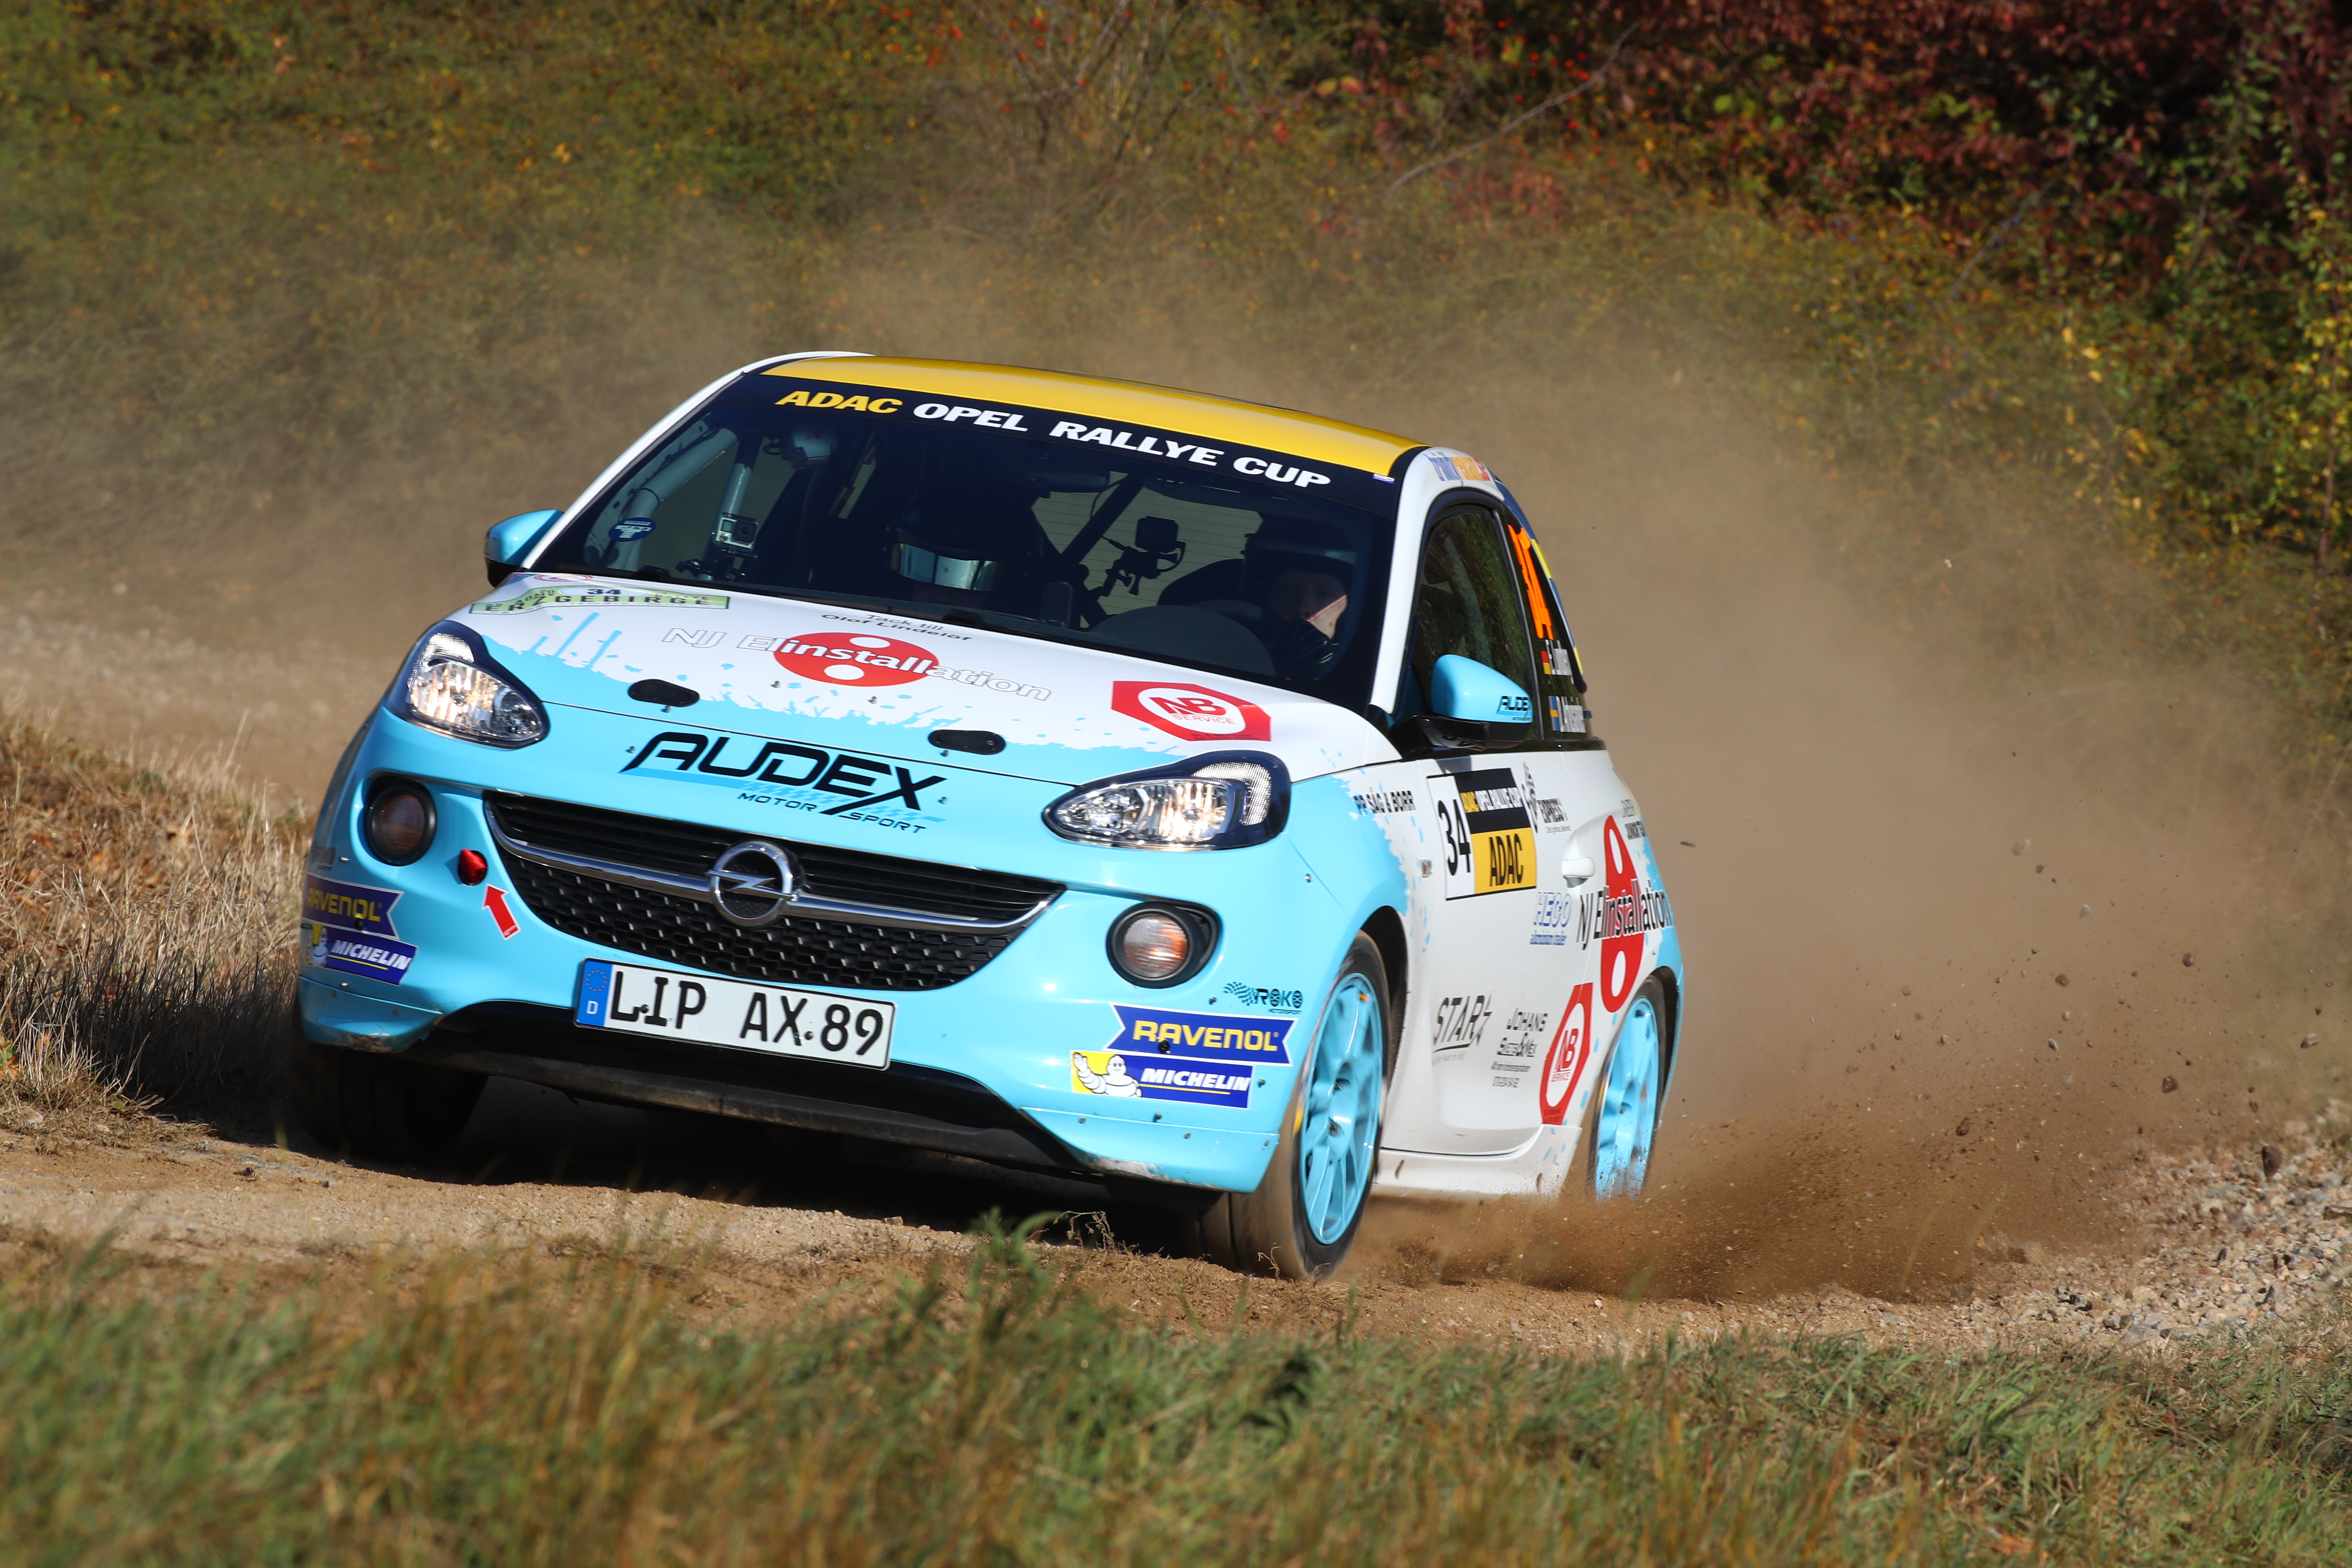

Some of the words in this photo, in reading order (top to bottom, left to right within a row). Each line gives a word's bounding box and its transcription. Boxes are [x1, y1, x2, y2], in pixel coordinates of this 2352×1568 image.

[775, 390, 903, 414] ADAC
[912, 402, 1029, 432] OPEL
[1049, 421, 1225, 467] RALLYE
[1232, 456, 1331, 489] CUP
[486, 595, 710, 611] ERZGEBIRGE
[821, 613, 873, 627] Olof
[876, 620, 973, 641] Lindelöf
[865, 614, 912, 626] Tack
[917, 621, 945, 631] till
[662, 628, 727, 648] NJ
[737, 633, 1052, 701] Elinstallation
[1148, 697, 1228, 715] NB
[1173, 714, 1236, 725] SERVICE
[619, 731, 947, 816] AUDEX
[737, 792, 818, 812] MOTOR
[839, 812, 927, 834] SPORT
[1390, 790, 1417, 812] BORR
[1438, 798, 1471, 876] 34
[1489, 833, 1524, 888] ADAC
[1576, 892, 1595, 951] NJ
[1593, 878, 1673, 940] Elinstallation
[331, 940, 412, 970] MICHELIN
[586, 1001, 598, 1015] D
[611, 971, 707, 1029] LIP
[740, 992, 808, 1046] AX
[821, 1004, 884, 1055] 89
[1506, 1007, 1549, 1032] JOHANS
[1132, 1020, 1279, 1051] RAVENOL
[1556, 1027, 1579, 1072] NB
[1139, 1068, 1250, 1092] MICHELIN
